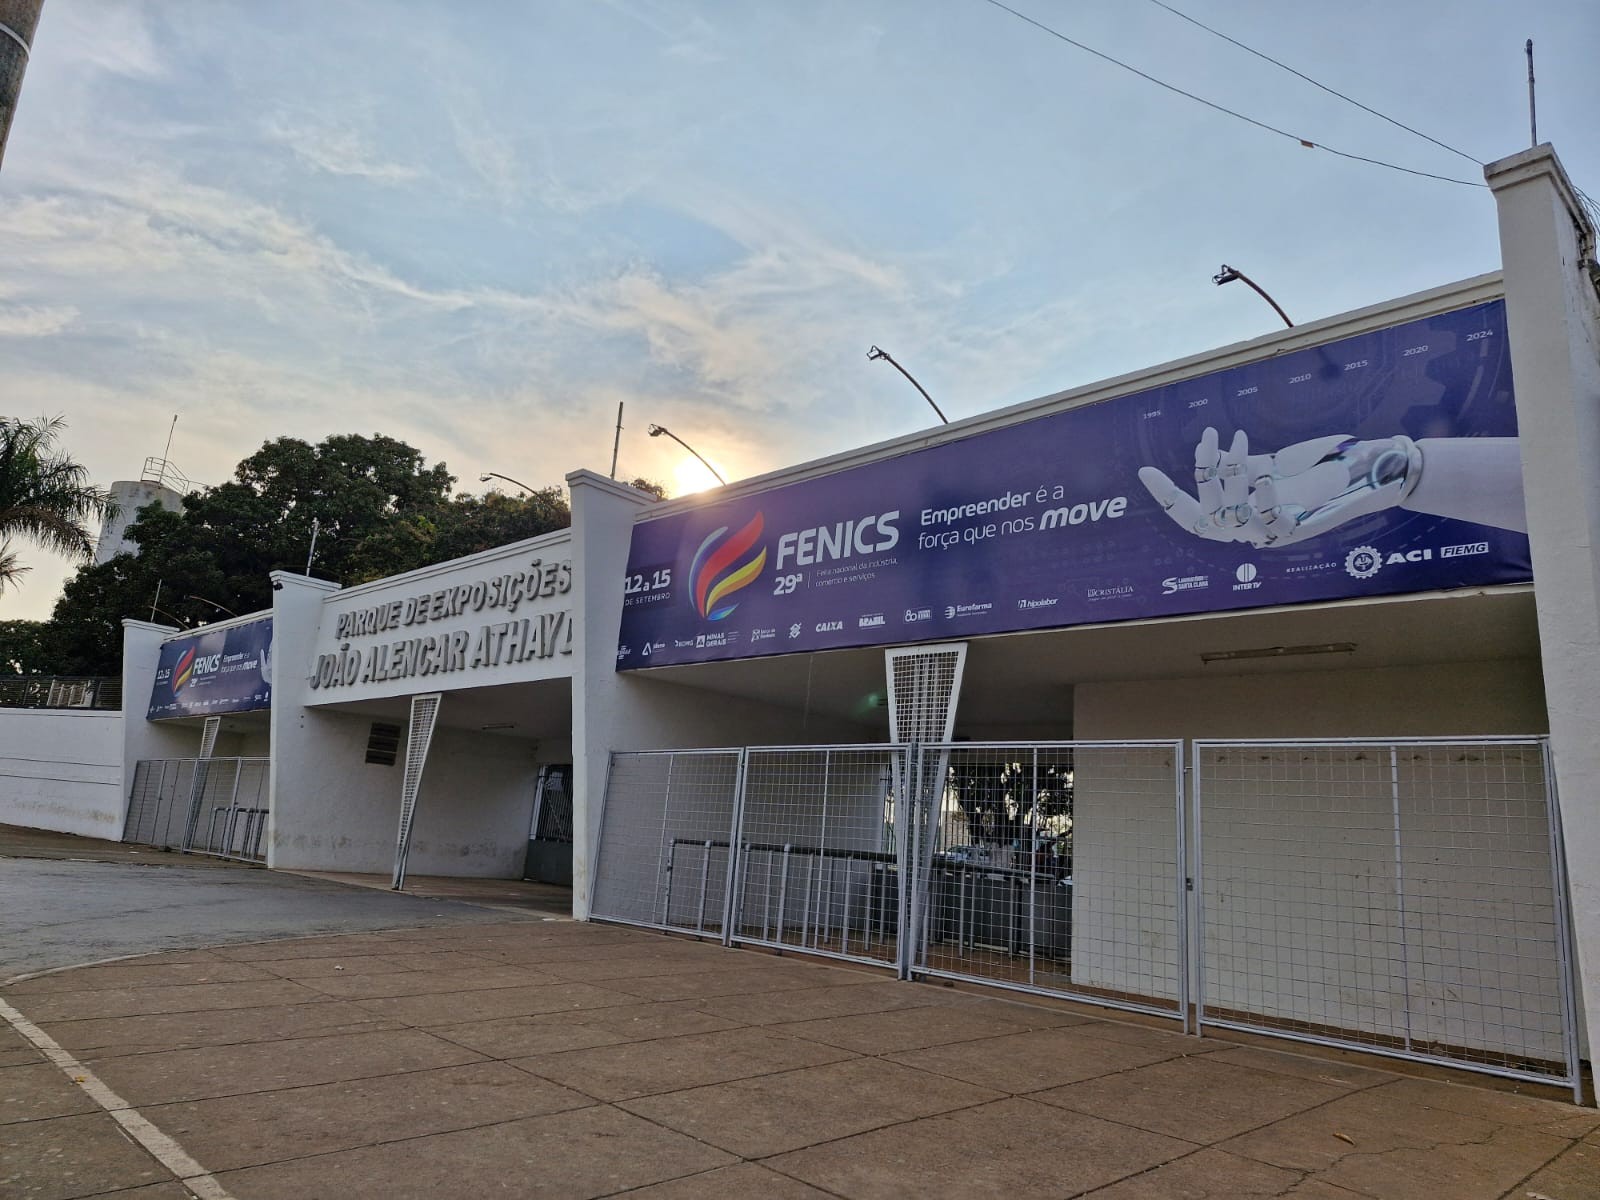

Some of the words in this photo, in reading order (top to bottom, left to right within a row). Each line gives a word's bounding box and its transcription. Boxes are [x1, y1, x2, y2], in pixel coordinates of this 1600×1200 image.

[1466, 329, 1494, 342] 2024
[1403, 345, 1429, 357] 2020
[1344, 359, 1369, 371] 2015
[1288, 373, 1312, 384] 2010
[1237, 386, 1258, 397] 2005
[1188, 398, 1208, 409] 2000
[1143, 409, 1161, 420] 1995
[921, 491, 1031, 526] Empreender
[1035, 485, 1047, 503] é
[1052, 485, 1064, 500] a
[918, 530, 959, 550] força
[964, 523, 996, 545] que
[1001, 516, 1034, 535] nos
[1039, 496, 1128, 531] move
[775, 510, 900, 570] FENICS
[1442, 543, 1488, 558] FIEMG
[1386, 549, 1432, 565] ACI
[625, 574, 643, 594] 12
[652, 569, 671, 589] 15
[1232, 583, 1253, 591] INTER
[335, 600, 403, 639] PARQUE
[401, 597, 429, 626] DE
[429, 558, 572, 620] EXPOSIÇÕES
[635, 592, 671, 605] SETEMBRO
[1027, 598, 1059, 609] hipolabor
[957, 602, 992, 612] Eurofarma
[815, 621, 843, 632] CAIXA
[706, 632, 725, 640] MINAS
[705, 639, 727, 647] GERAIS
[192, 654, 221, 676] FENICS
[309, 643, 362, 690] JOÃO
[360, 630, 470, 683] ALENCAR
